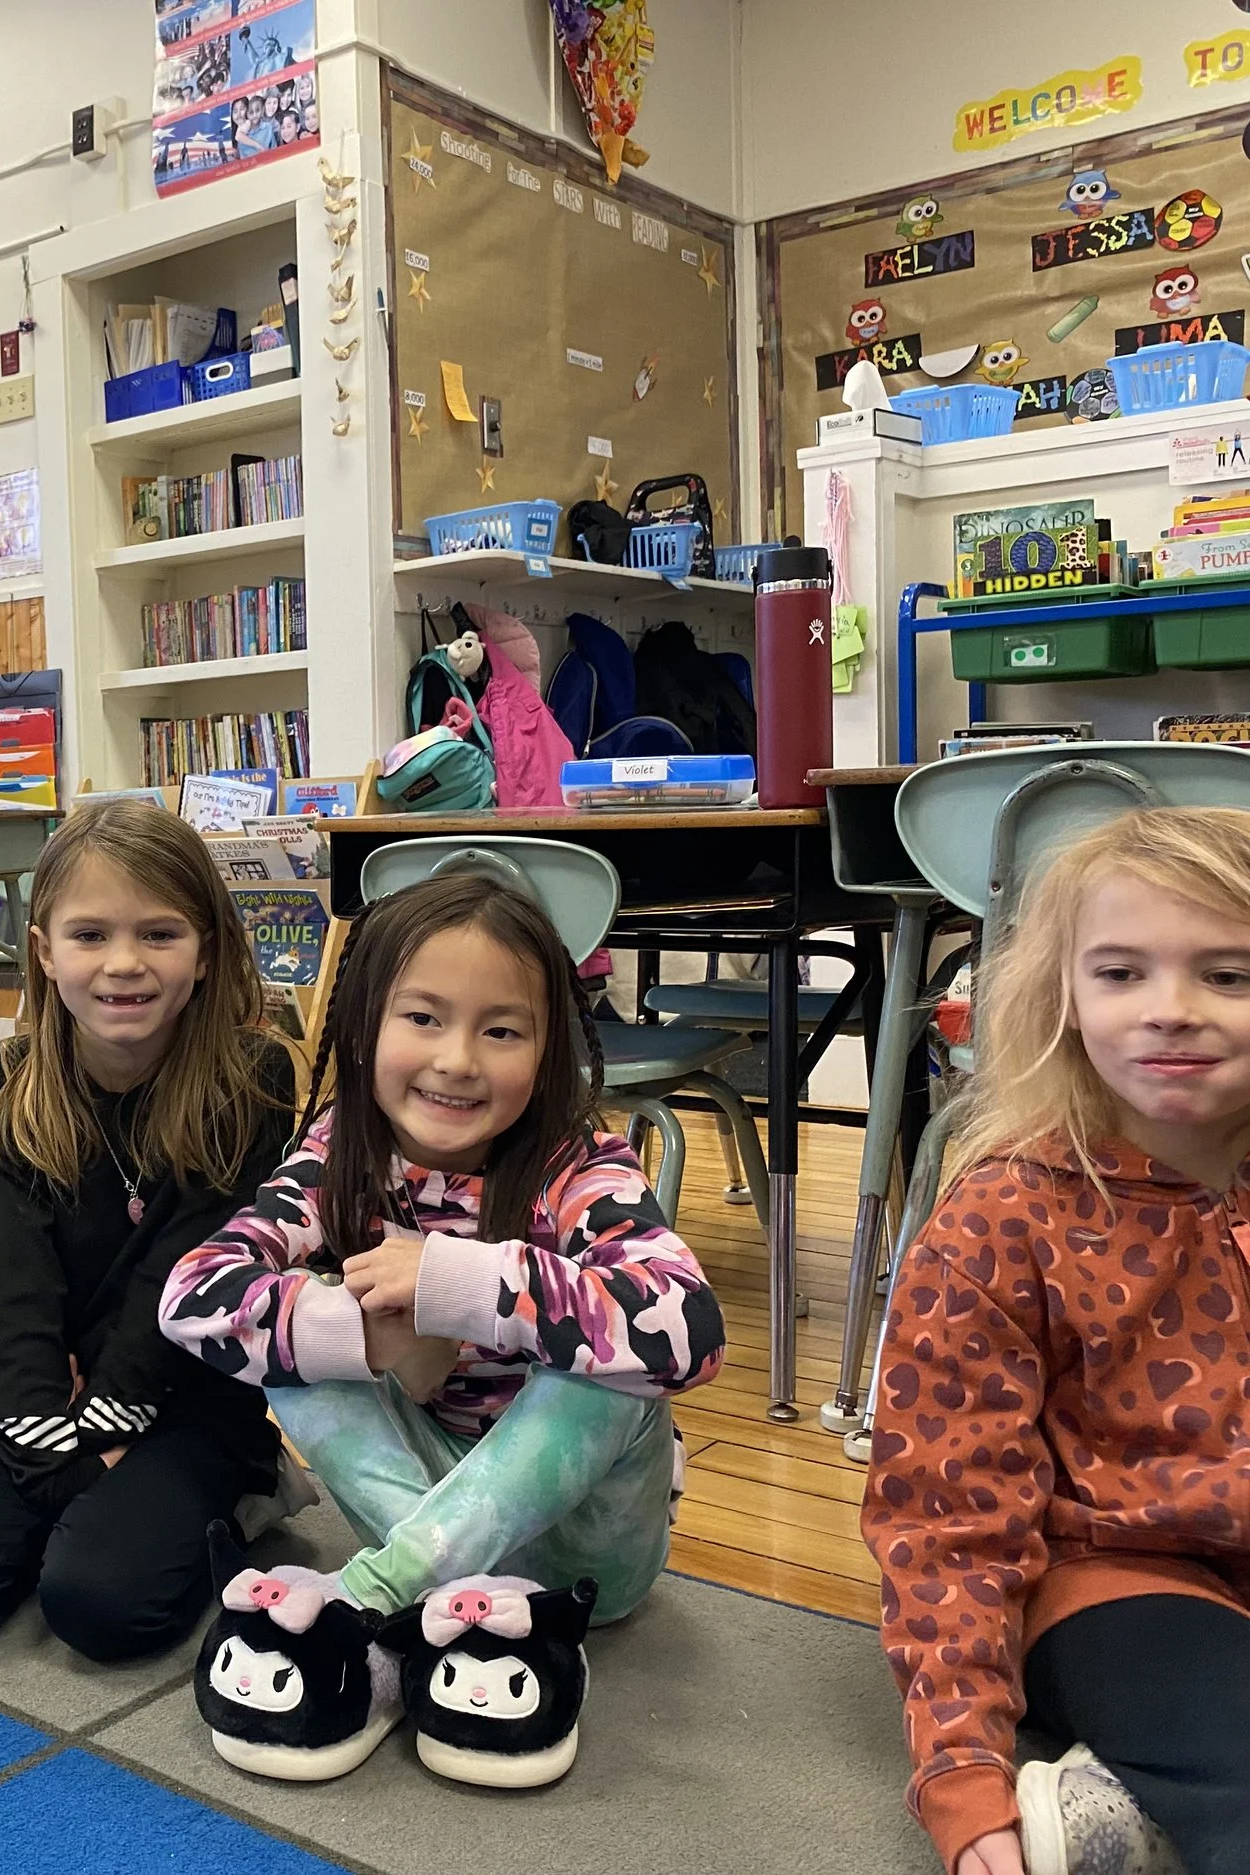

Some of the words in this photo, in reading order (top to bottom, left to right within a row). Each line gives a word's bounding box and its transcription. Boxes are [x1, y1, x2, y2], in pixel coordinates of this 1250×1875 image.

[965, 69, 1128, 140] WELCOME
[1194, 42, 1244, 78] TO
[441, 131, 491, 173] Shooting
[553, 180, 583, 213] STARS
[593, 198, 621, 229] With
[1035, 213, 1154, 267] JESSA
[868, 232, 973, 284] FAELYN
[405, 391, 425, 405] 8,000
[977, 525, 1094, 582] 101
[1202, 542, 1236, 554] From
[985, 569, 1084, 595] HIDDEN
[624, 764, 655, 775] Violet
[296, 785, 338, 797] Clifford
[256, 827, 309, 838] CHRISTMAS
[210, 840, 269, 850] RANDMA'S
[279, 836, 303, 844] OLLS
[212, 849, 251, 859] ATKES
[256, 924, 319, 947] OLIVE,
